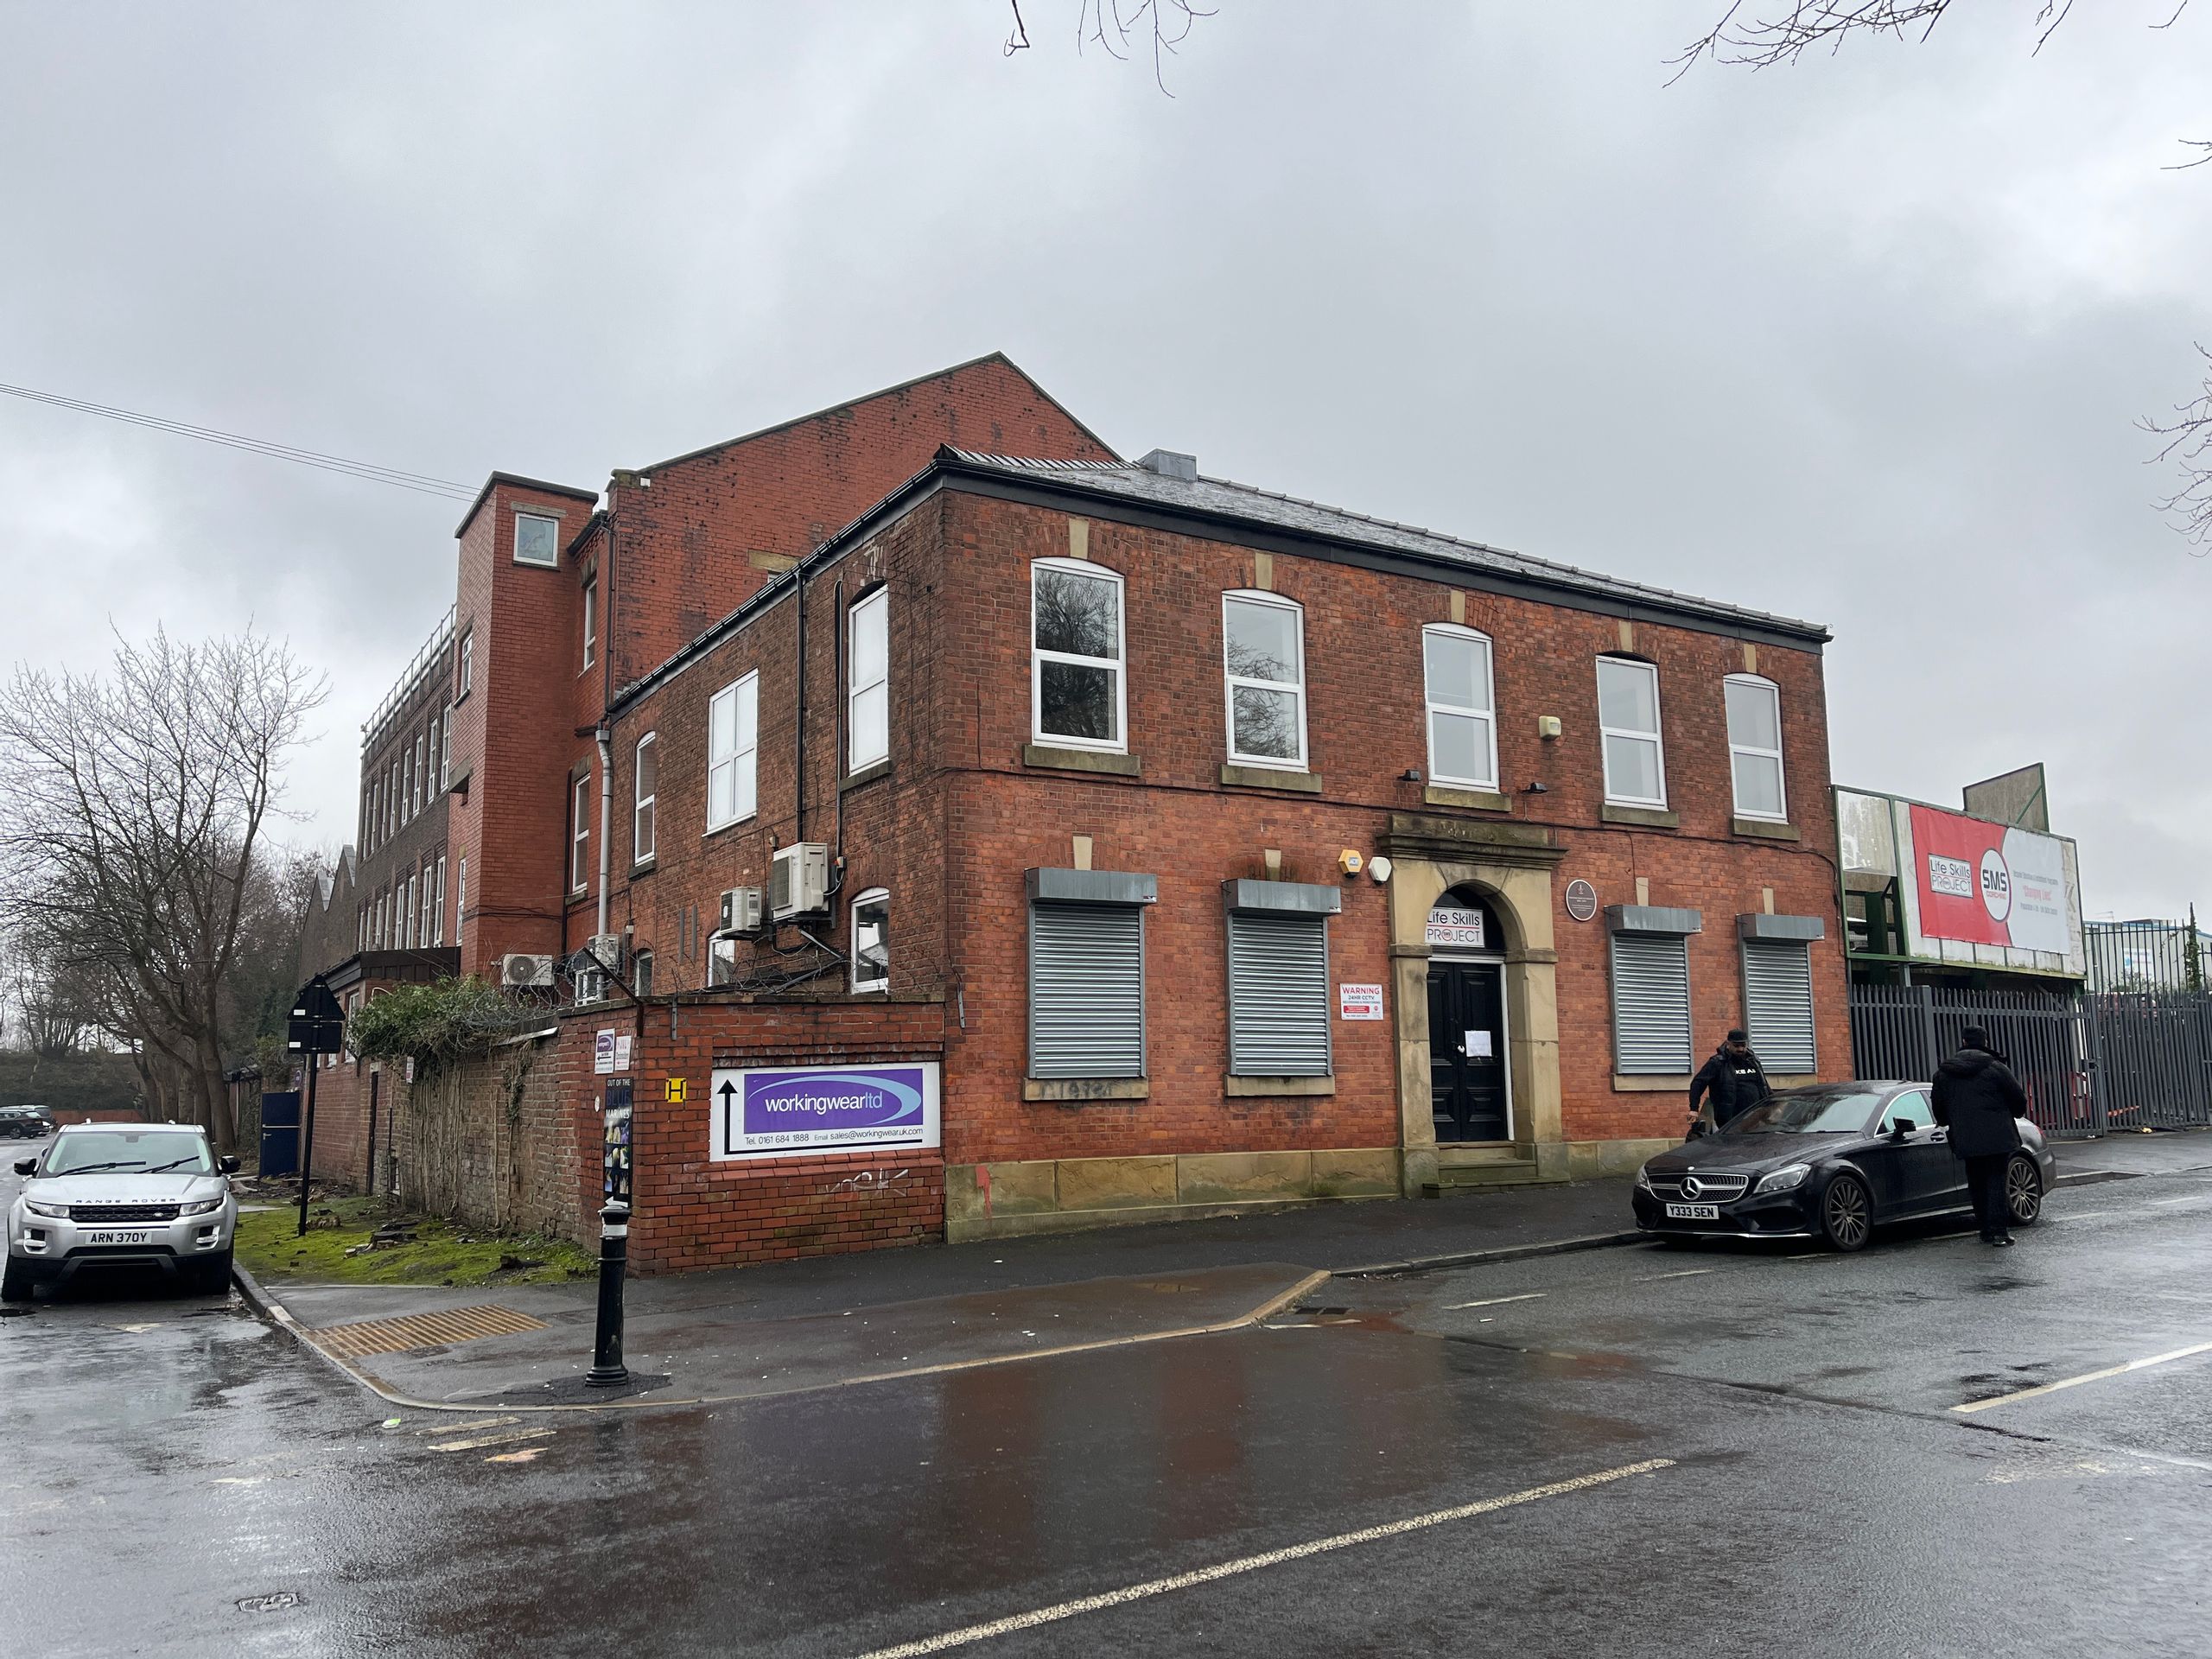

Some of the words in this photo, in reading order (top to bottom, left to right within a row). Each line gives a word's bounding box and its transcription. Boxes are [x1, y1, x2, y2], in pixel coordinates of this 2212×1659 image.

[1930, 860, 1947, 874] Life
[1950, 863, 1970, 879] Skills
[1931, 875, 1971, 892] PROJECT
[1982, 868, 2007, 892] SMS
[1452, 912, 1480, 925] Skills
[1427, 929, 1480, 942] PROJECT
[669, 1081, 683, 1099] H
[607, 1089, 630, 1106] BLUE
[606, 1109, 630, 1119] MARINES
[758, 1135, 773, 1145] 0161
[775, 1135, 790, 1143] 684
[792, 1134, 810, 1142] 1888
[1669, 1205, 1692, 1217] Y333
[1694, 1207, 1714, 1217] SEN
[90, 1233, 113, 1243] ARN
[117, 1232, 147, 1243] 370Y
